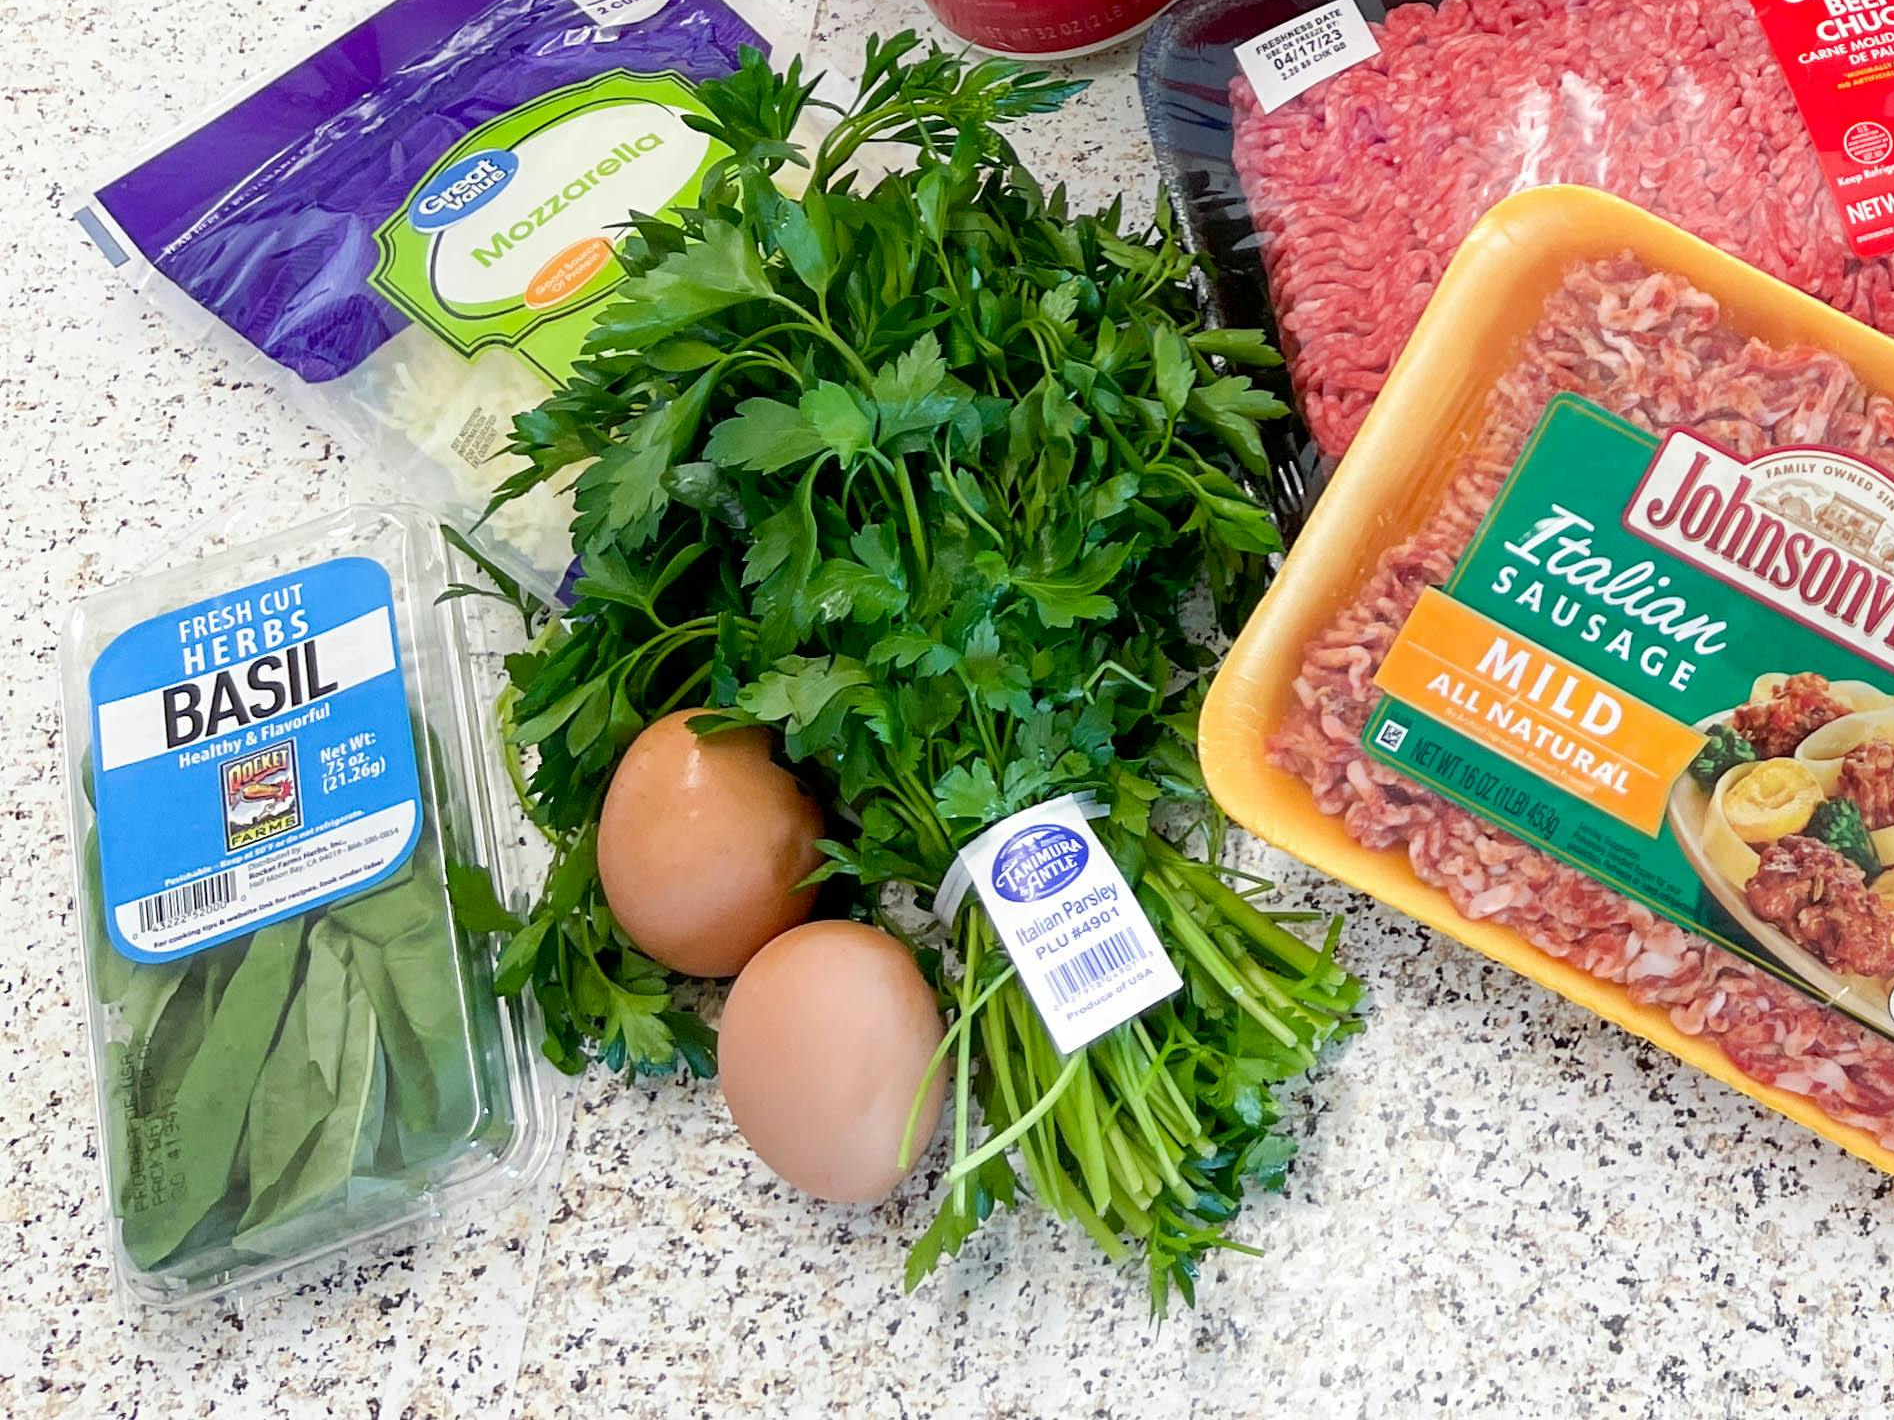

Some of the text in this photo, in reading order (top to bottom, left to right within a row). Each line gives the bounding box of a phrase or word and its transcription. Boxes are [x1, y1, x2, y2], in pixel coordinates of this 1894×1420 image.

[596, 6, 609, 15] 2
[1256, 8, 1343, 55] FRESHNESS DATE
[1274, 29, 1343, 71] 04/17/23
[1798, 44, 1848, 64] CARNE
[1849, 52, 1869, 66] DE
[418, 158, 500, 216] Great
[446, 168, 508, 212] Value
[470, 132, 664, 270] Mozzarella
[1837, 173, 1863, 187] Keep
[1766, 463, 1816, 478] FAMILY
[1823, 465, 1873, 492] OWNED
[1503, 503, 1728, 657] Italian
[178, 583, 304, 645] FRESH CUT
[1491, 566, 1698, 694] SAUSAGE
[181, 609, 311, 676] HERBS
[162, 639, 338, 749] BASIL
[1476, 637, 1623, 736] MILD
[179, 702, 331, 769] Healthy & Flavorful
[320, 732, 376, 763] Net Wt:
[1426, 671, 1480, 714] ALL
[1487, 704, 1629, 795] NATURAL
[227, 748, 289, 788] ROCKET
[321, 753, 370, 780] .75 oz.
[322, 756, 386, 795] (21.26g)
[230, 816, 295, 847] FARMS
[996, 838, 1083, 891] TANIMURA
[1015, 883, 1119, 947] Italian Parsley
[1035, 907, 1121, 960] PLU #4901
[1067, 967, 1154, 1021] Produce of USA
